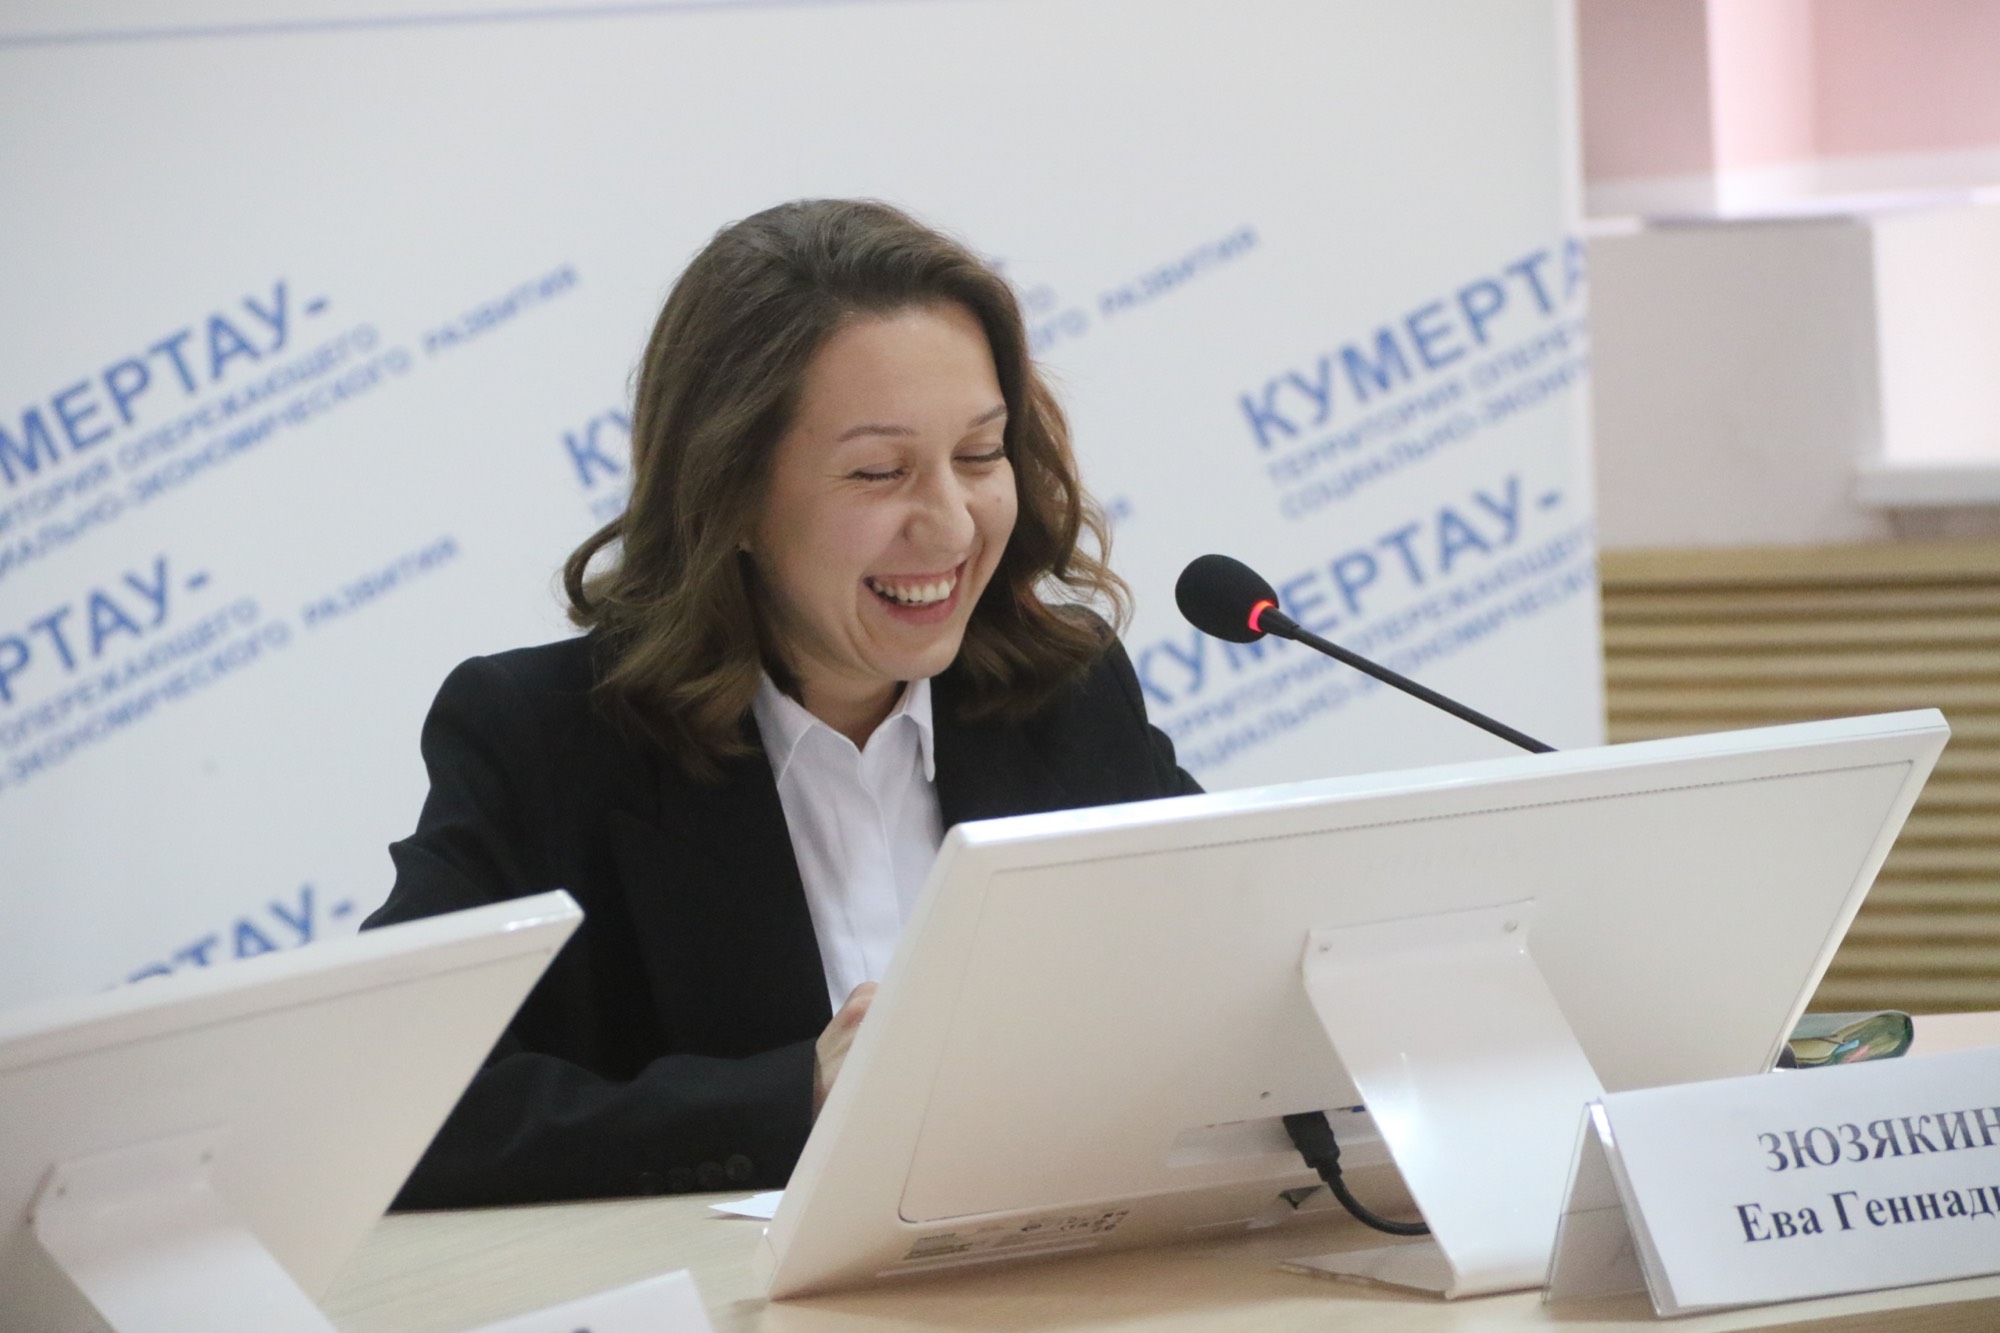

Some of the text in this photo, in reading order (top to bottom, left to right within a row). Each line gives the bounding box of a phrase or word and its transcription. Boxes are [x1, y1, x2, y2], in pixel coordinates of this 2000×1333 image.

[421, 262, 583, 358] РАЗВИТИЯ
[0, 278, 329, 487] МЕРТАУ-
[300, 534, 460, 632] РАЗВИТИЯ
[1757, 1106, 2000, 1173] ЗЮЗЯКИН
[1733, 1202, 1823, 1243] Ева
